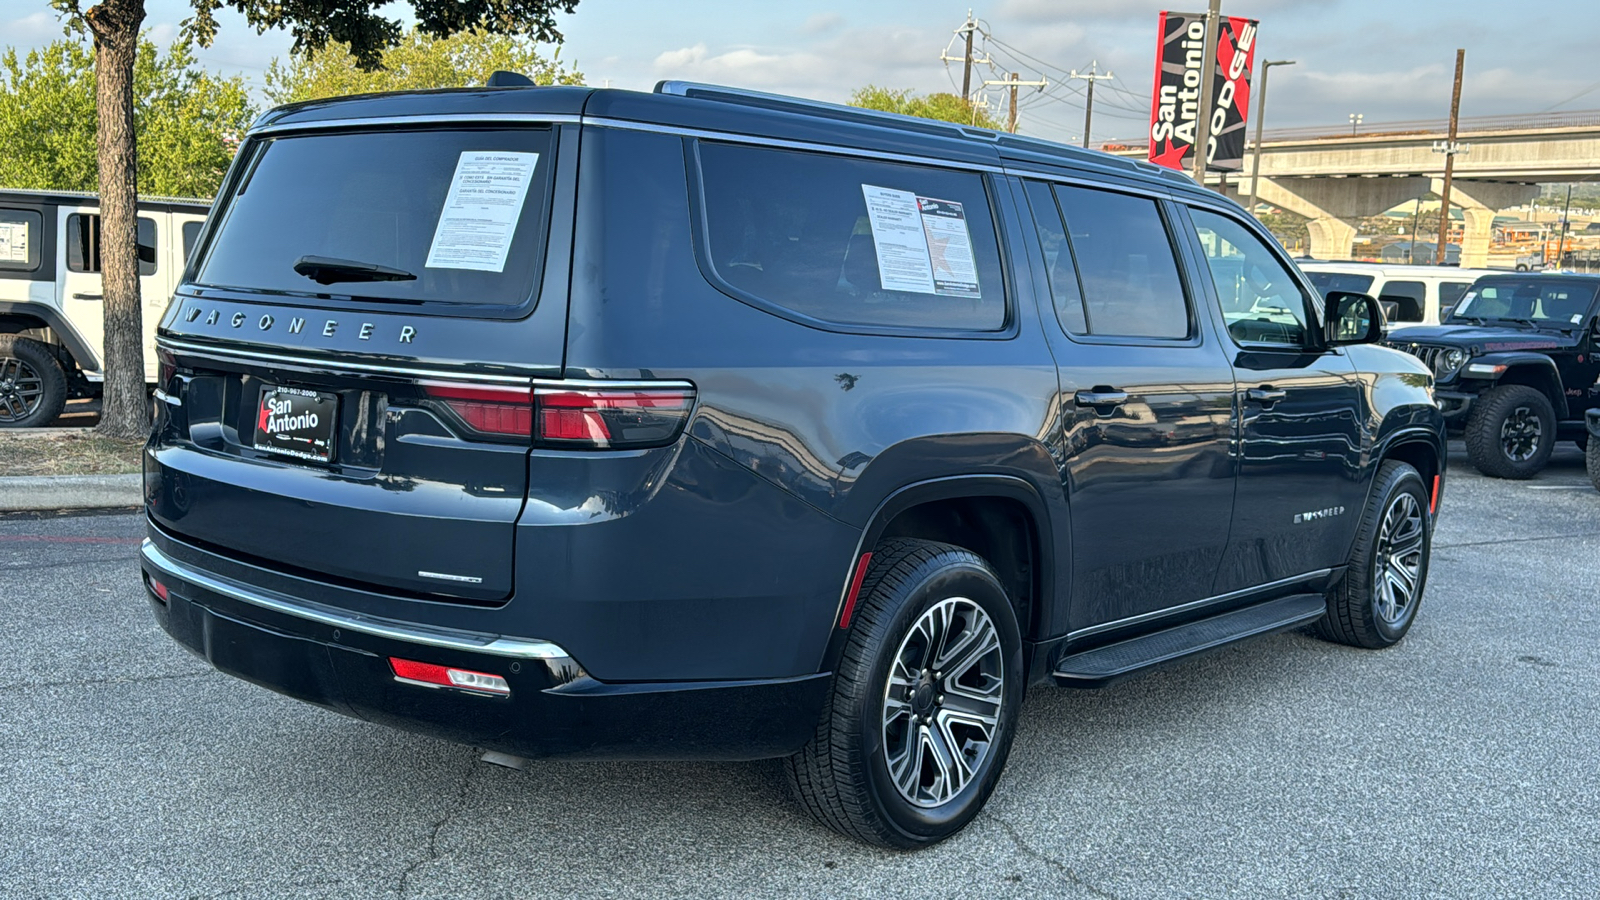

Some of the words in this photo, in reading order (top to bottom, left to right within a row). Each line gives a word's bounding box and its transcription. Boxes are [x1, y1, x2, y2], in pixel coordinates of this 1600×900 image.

[1174, 21, 1205, 144] Antonio
[1206, 22, 1257, 165] DODGE
[1152, 85, 1178, 142] San
[185, 306, 417, 344] WAGONEER
[268, 398, 292, 416] San
[1566, 388, 1582, 397] Jeep
[267, 410, 318, 434] Antonio
[254, 443, 328, 462] SanAntonioDodge.com
